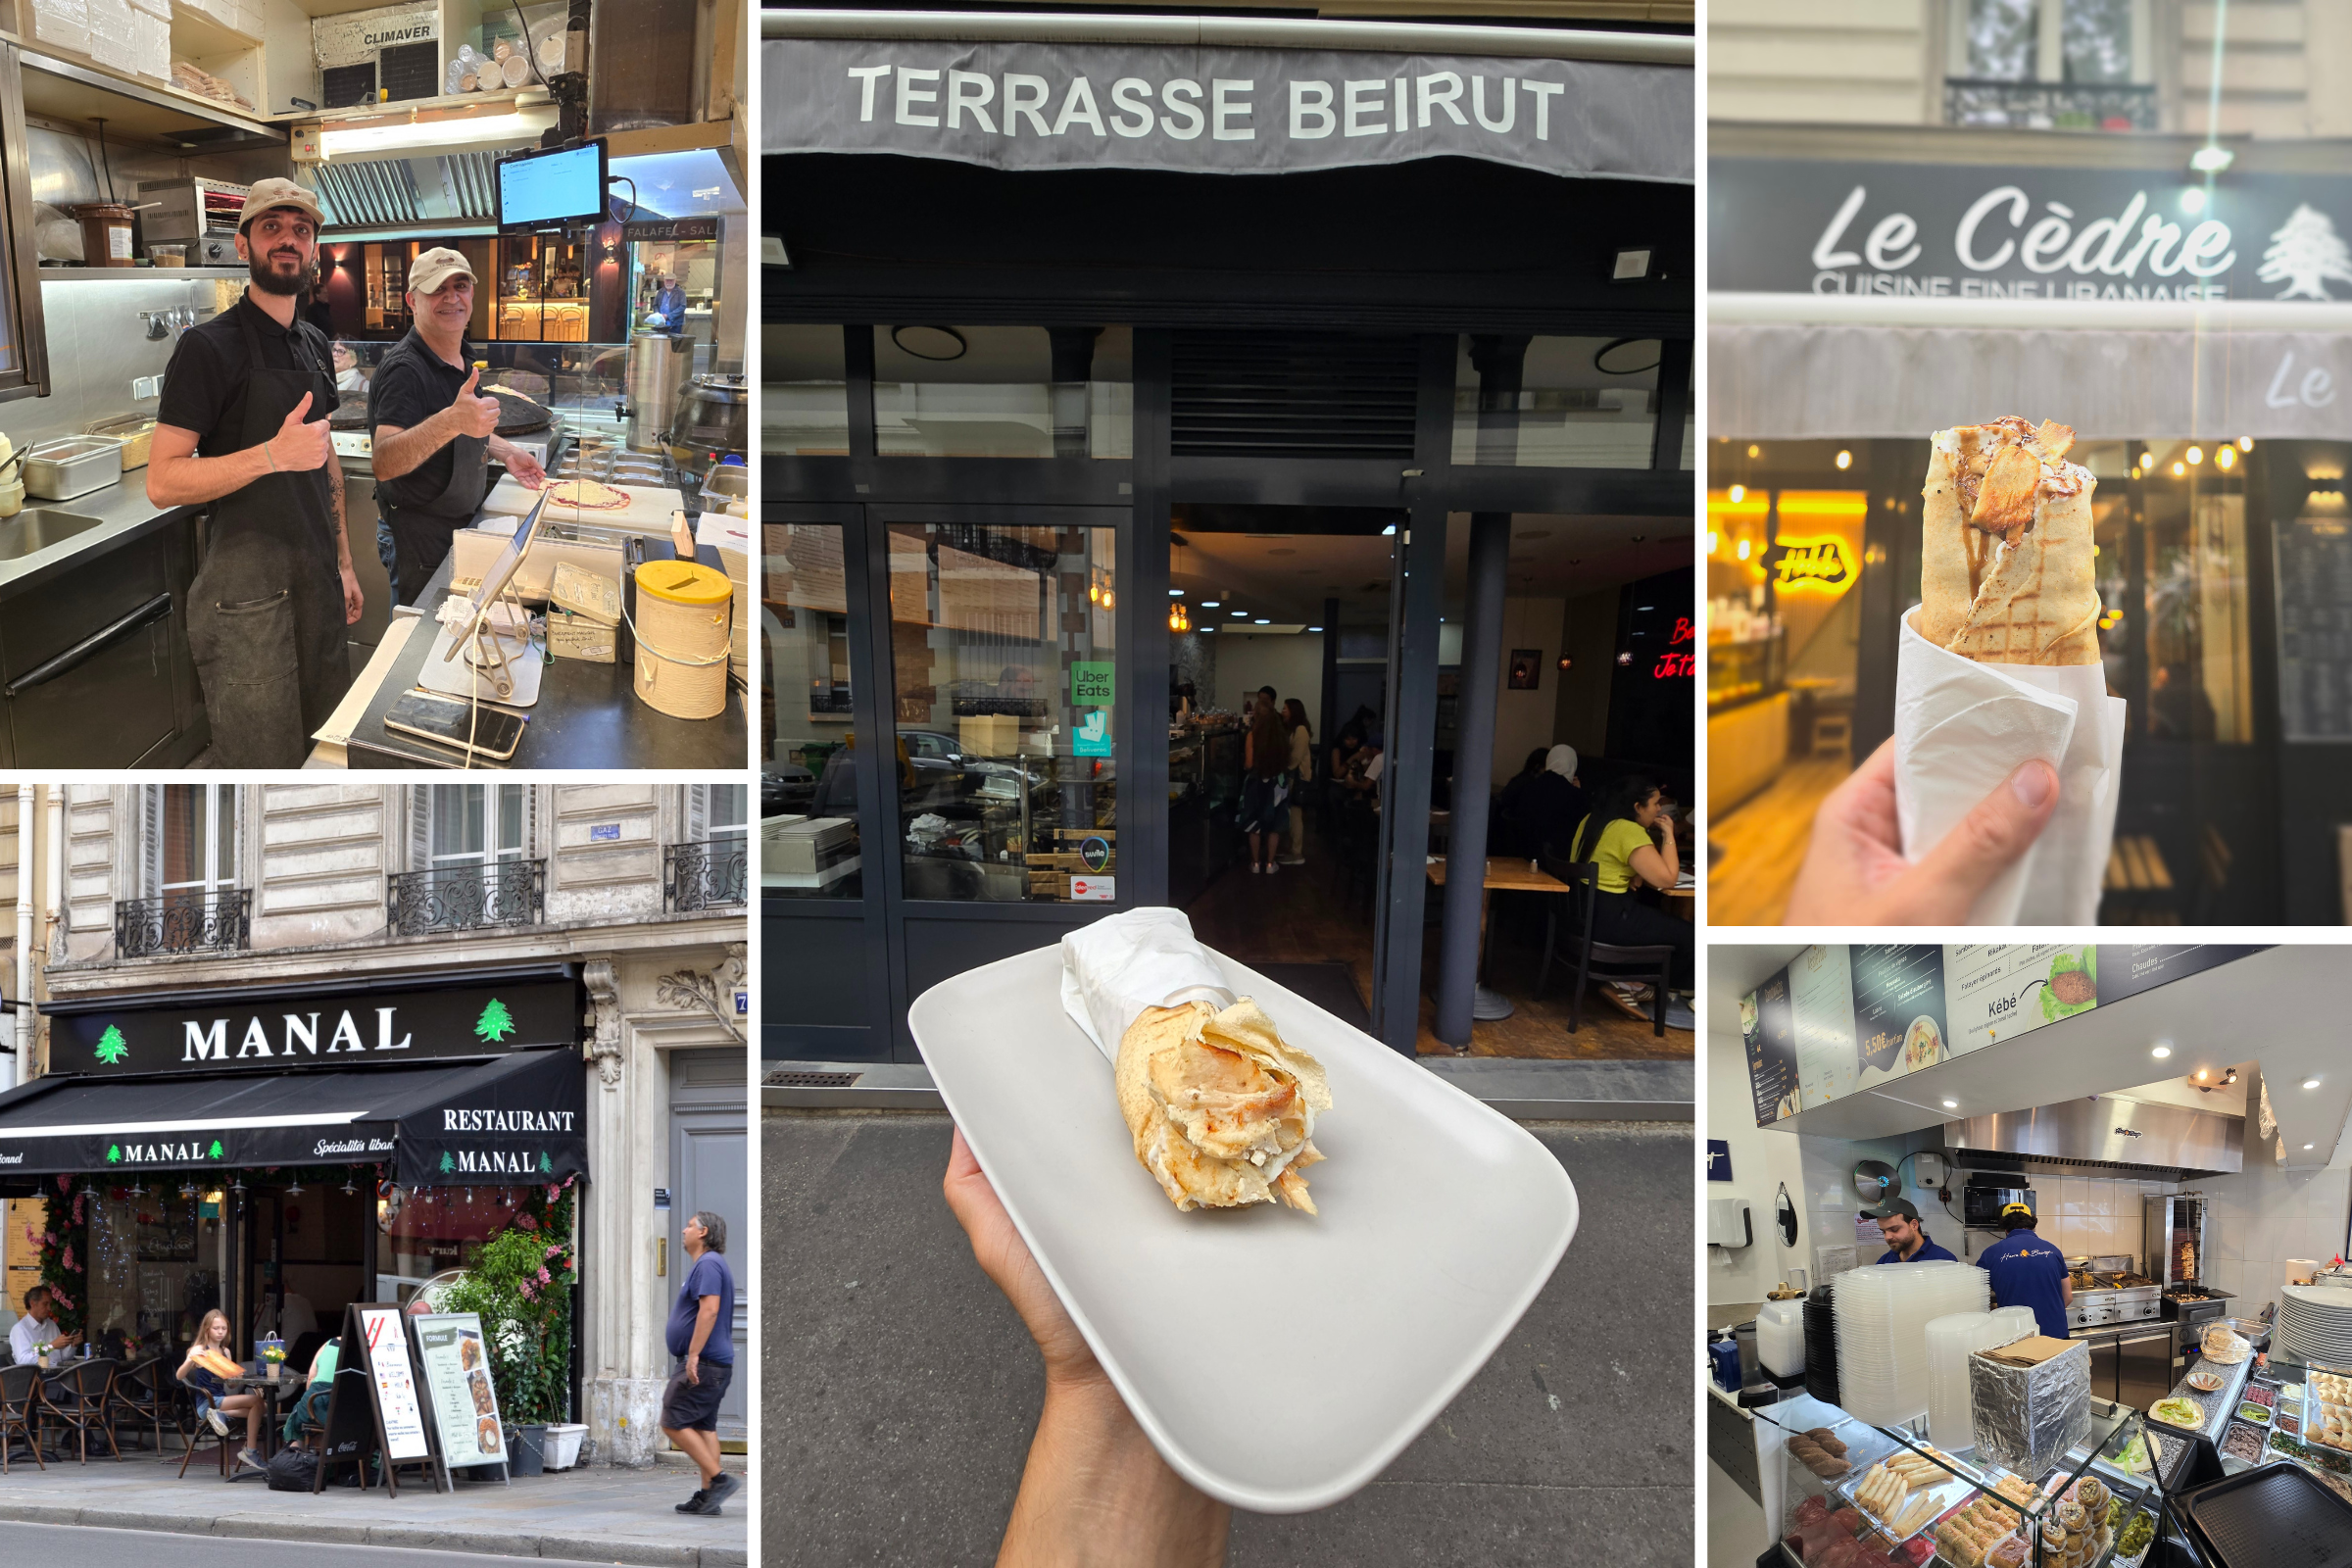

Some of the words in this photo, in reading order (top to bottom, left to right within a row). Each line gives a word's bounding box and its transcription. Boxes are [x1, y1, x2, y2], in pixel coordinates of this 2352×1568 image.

[364, 25, 430, 45] CLIMAVER
[847, 64, 1255, 140] TERRASSE
[1289, 71, 1565, 141] BEIRUT
[627, 226, 679, 237] FALAFEL
[690, 225, 718, 236] SAL
[1812, 185, 1922, 270] Le
[1954, 185, 2236, 278] Cèdre
[2266, 350, 2338, 410] Le
[1076, 670, 1109, 683] Uber
[1077, 684, 1110, 697] Eats
[2132, 956, 2158, 973] Chaudes
[1988, 992, 2017, 1017] Kébé
[181, 1007, 412, 1061] MANAL
[443, 1109, 574, 1132] RESTAURANT
[124, 1143, 204, 1162] MANAL
[314, 1139, 365, 1157] Spécialités
[368, 1138, 394, 1152] liban
[459, 1151, 536, 1173] MANAL
